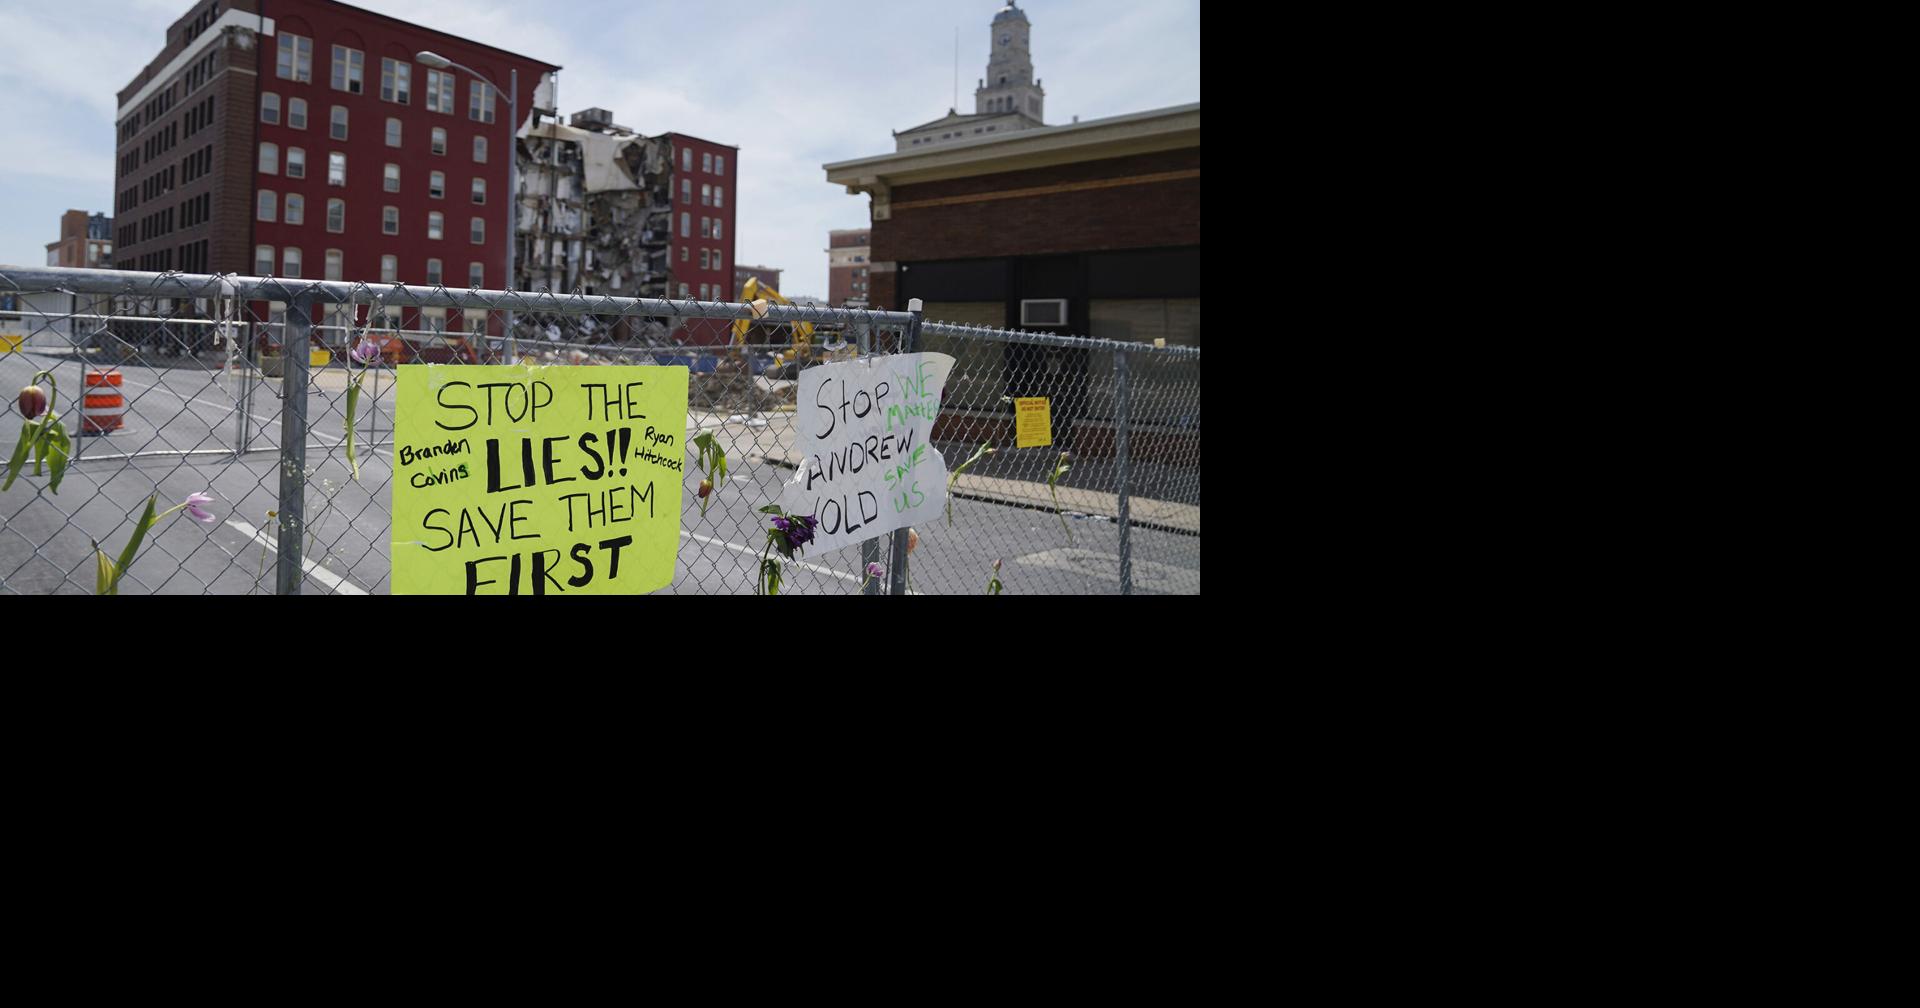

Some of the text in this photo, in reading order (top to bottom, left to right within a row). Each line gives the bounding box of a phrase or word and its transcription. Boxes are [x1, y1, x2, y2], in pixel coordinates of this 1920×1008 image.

[895, 360, 936, 399] WE
[435, 381, 646, 430] STOP THE
[400, 439, 471, 465] Branden
[645, 426, 674, 446] Ryan
[410, 463, 470, 488] Covins
[486, 427, 631, 493] LIES!!
[635, 447, 683, 472] Hitchcock
[807, 428, 913, 490] ANDREW
[884, 444, 927, 491] SAVE
[422, 481, 654, 552] SAVE THEM
[813, 490, 878, 535] OLD
[894, 481, 925, 513] US
[465, 535, 633, 595] FIRST
